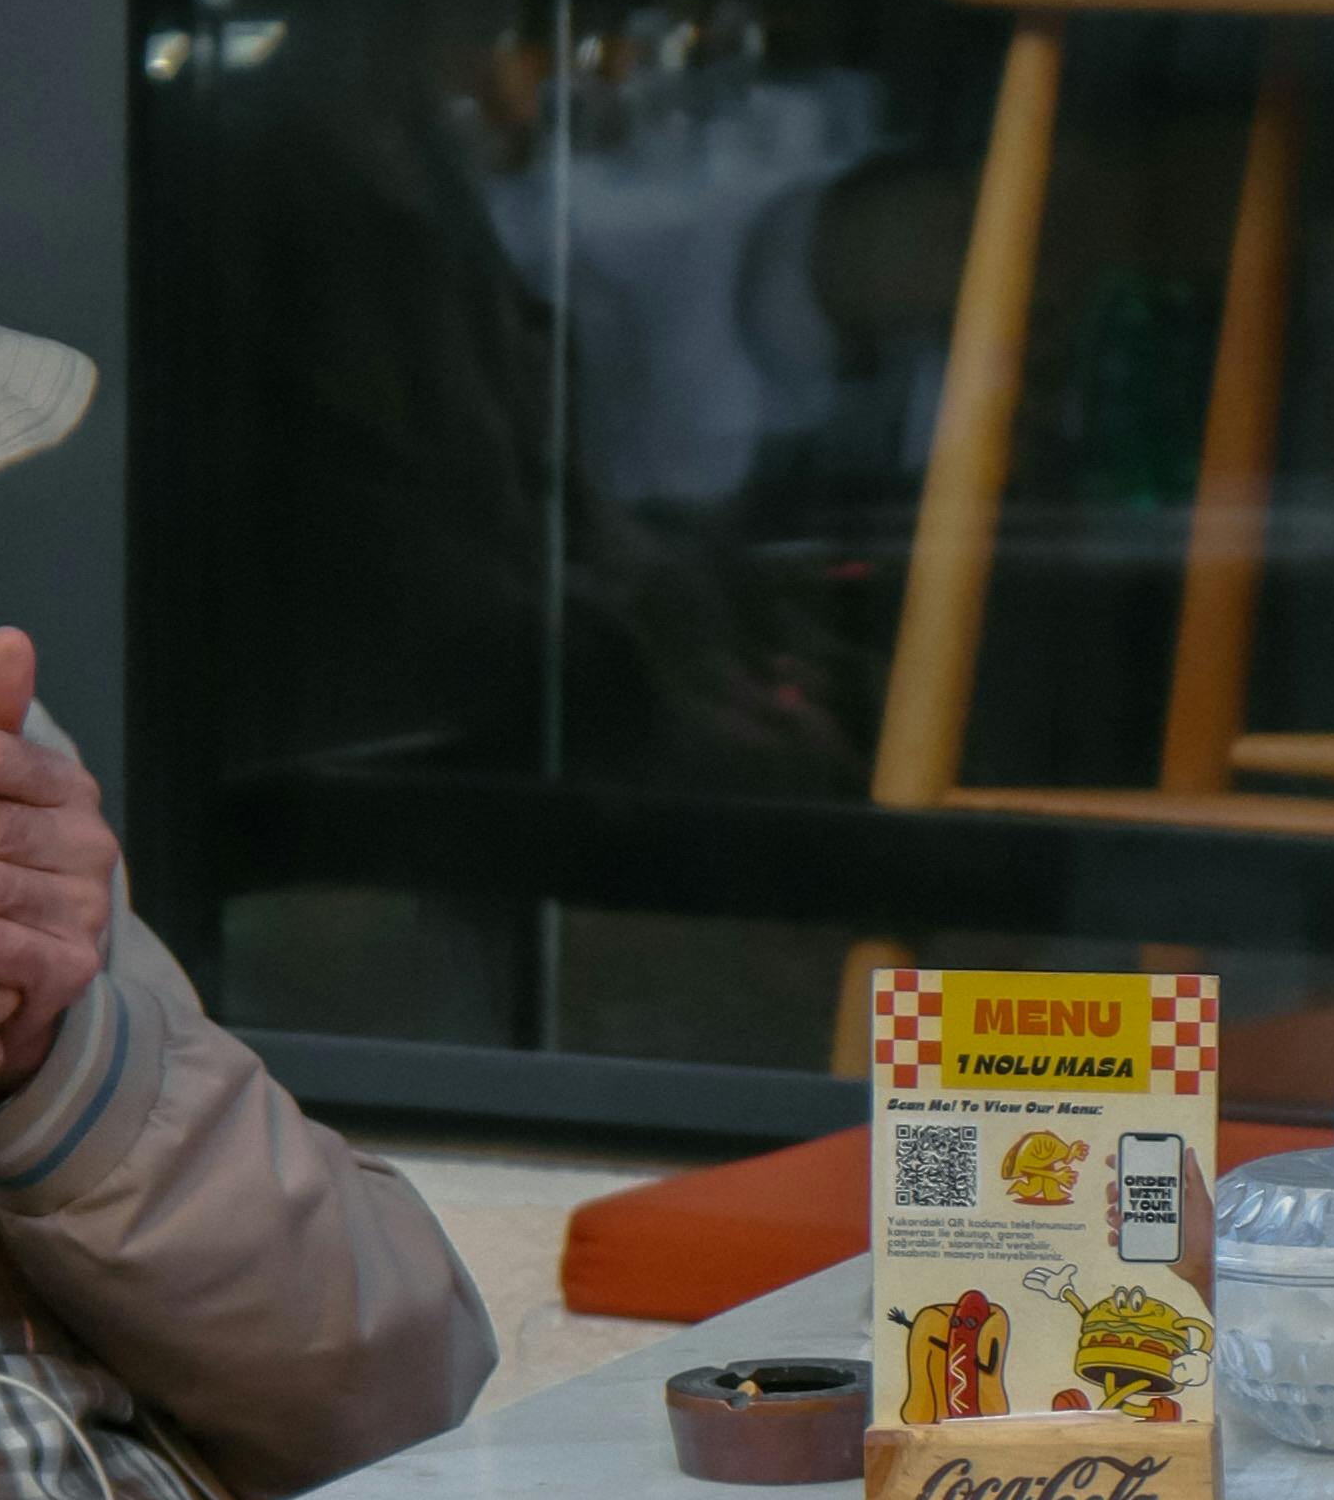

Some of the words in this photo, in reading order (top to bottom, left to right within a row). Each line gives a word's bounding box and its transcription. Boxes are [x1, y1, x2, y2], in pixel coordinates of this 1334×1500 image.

[973, 998, 1122, 1038] MENU
[957, 1054, 970, 1074] 1
[973, 1055, 1051, 1076] NOLU
[1054, 1056, 1134, 1078] MASA
[887, 1098, 924, 1111] Scan
[928, 1100, 955, 1112] Me!
[961, 1100, 979, 1112] To
[985, 1100, 1022, 1112] View
[1025, 1101, 1054, 1114] Our
[1057, 1102, 1103, 1115] Menu:
[1124, 1175, 1178, 1187] ORDER
[1129, 1188, 1173, 1199] WITH
[1129, 1200, 1173, 1211] YOUR
[948, 1218, 964, 1228] QR
[1123, 1212, 1177, 1224] PHONE
